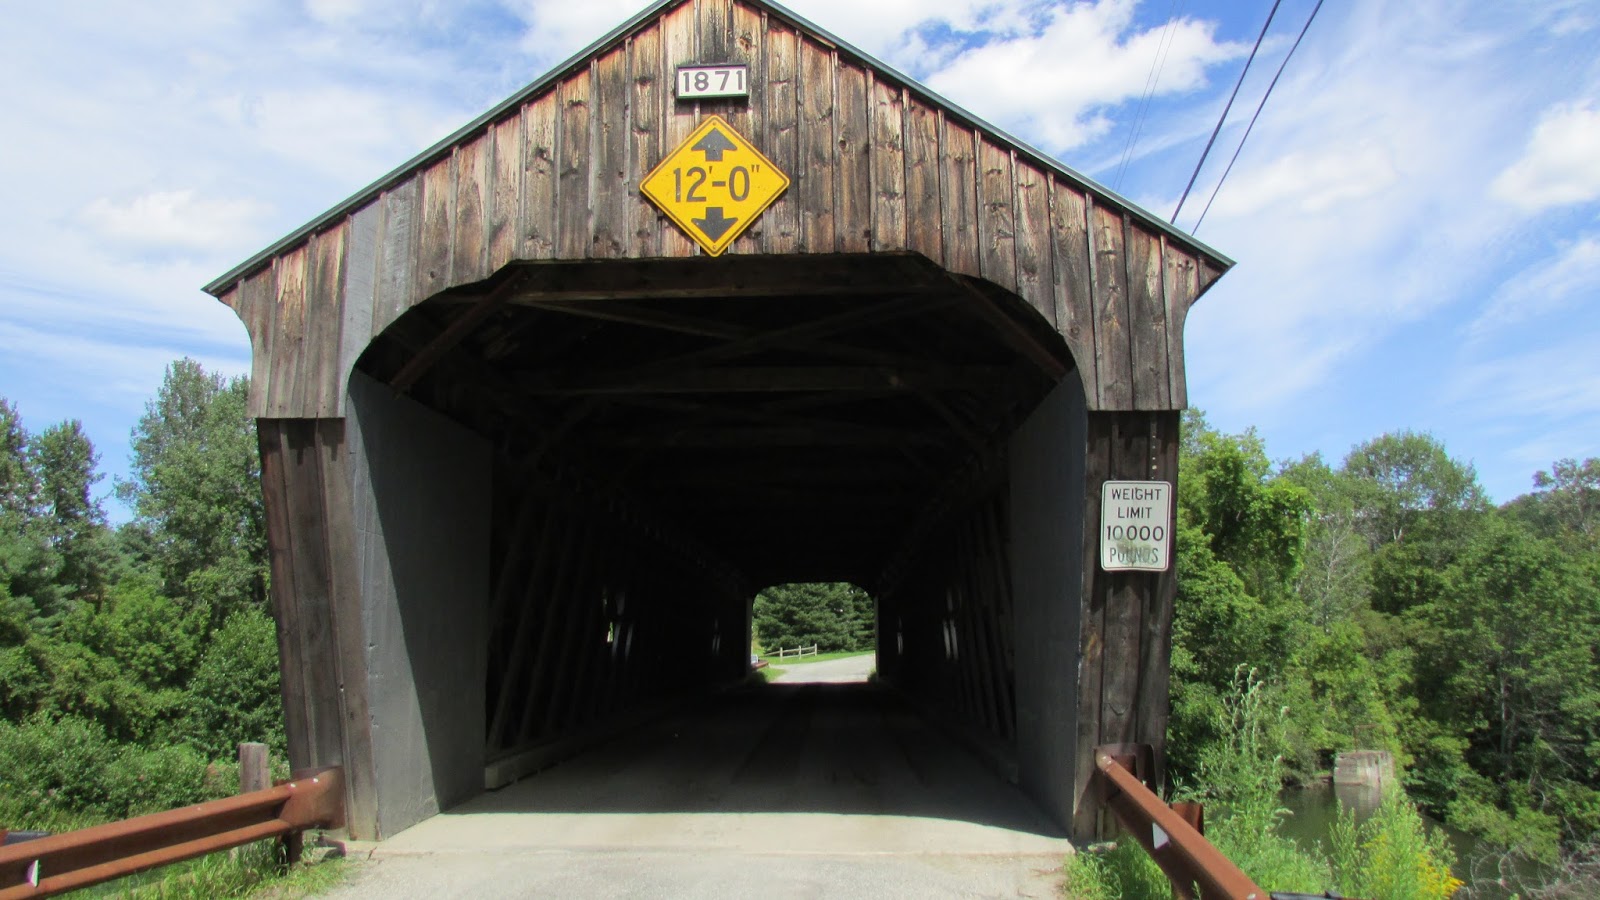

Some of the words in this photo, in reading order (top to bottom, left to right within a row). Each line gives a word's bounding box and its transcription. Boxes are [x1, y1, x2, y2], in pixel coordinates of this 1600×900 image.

[683, 70, 743, 92] 1871
[1112, 487, 1162, 500] WEIGHT
[1118, 507, 1152, 519] LIMIT
